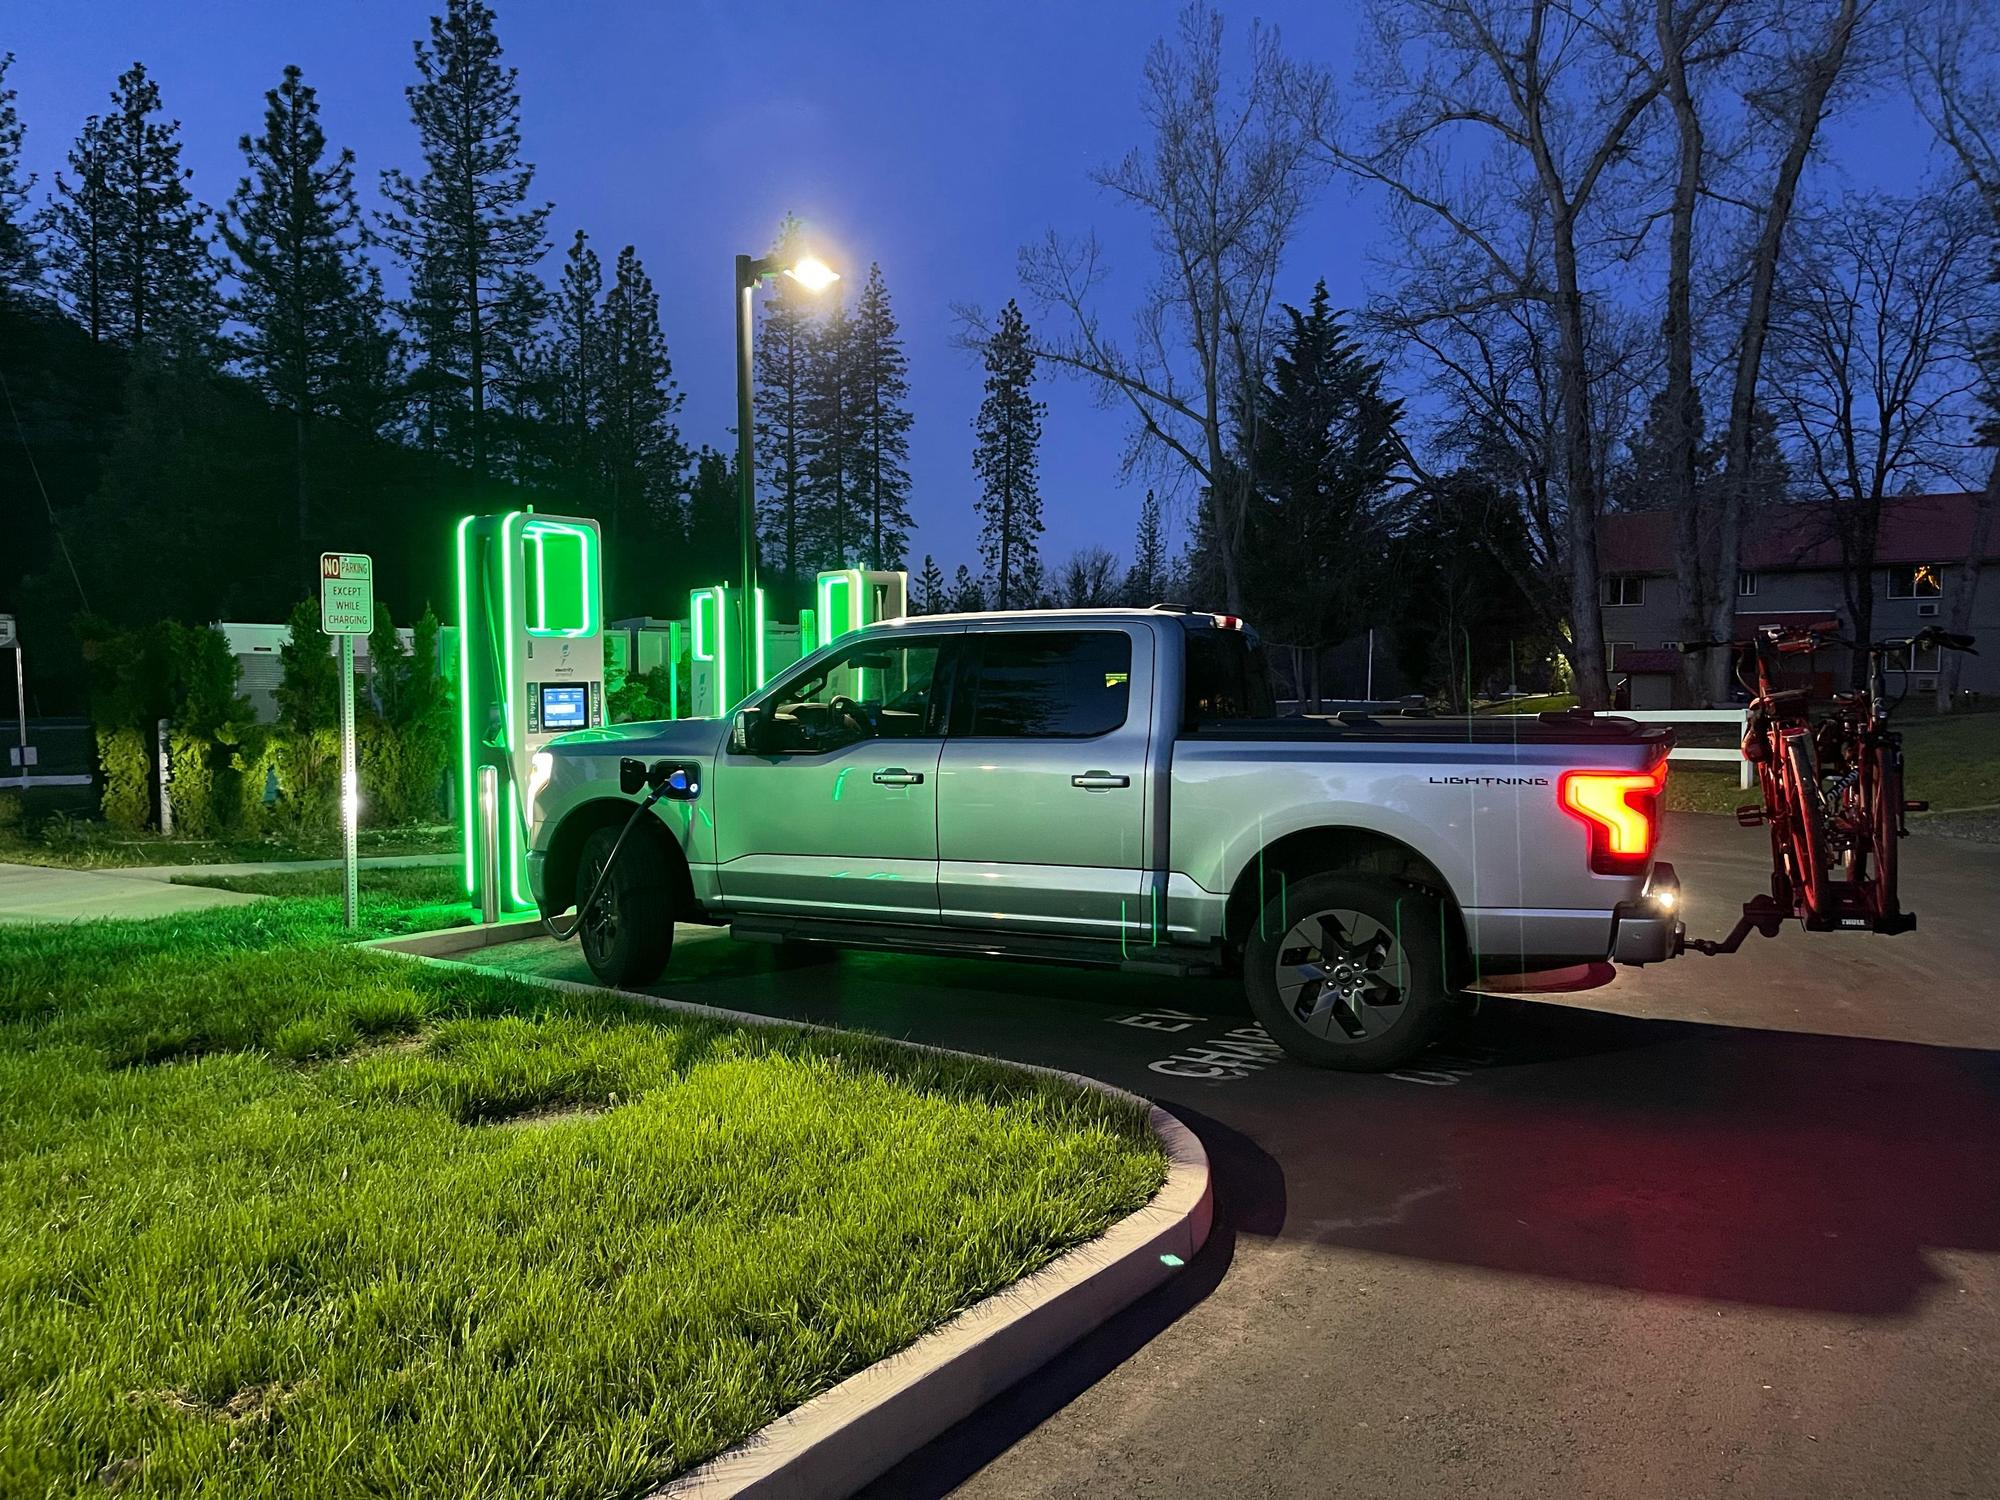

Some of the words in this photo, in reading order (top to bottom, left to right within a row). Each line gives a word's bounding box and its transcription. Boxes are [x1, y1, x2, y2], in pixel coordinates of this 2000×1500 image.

[324, 558, 339, 576] NO
[341, 562, 368, 574] PARKING
[333, 586, 361, 596] EXCEPT
[336, 601, 360, 611] WHILE
[328, 615, 368, 625] CHARGING
[1429, 776, 1549, 788] LIGHTNING
